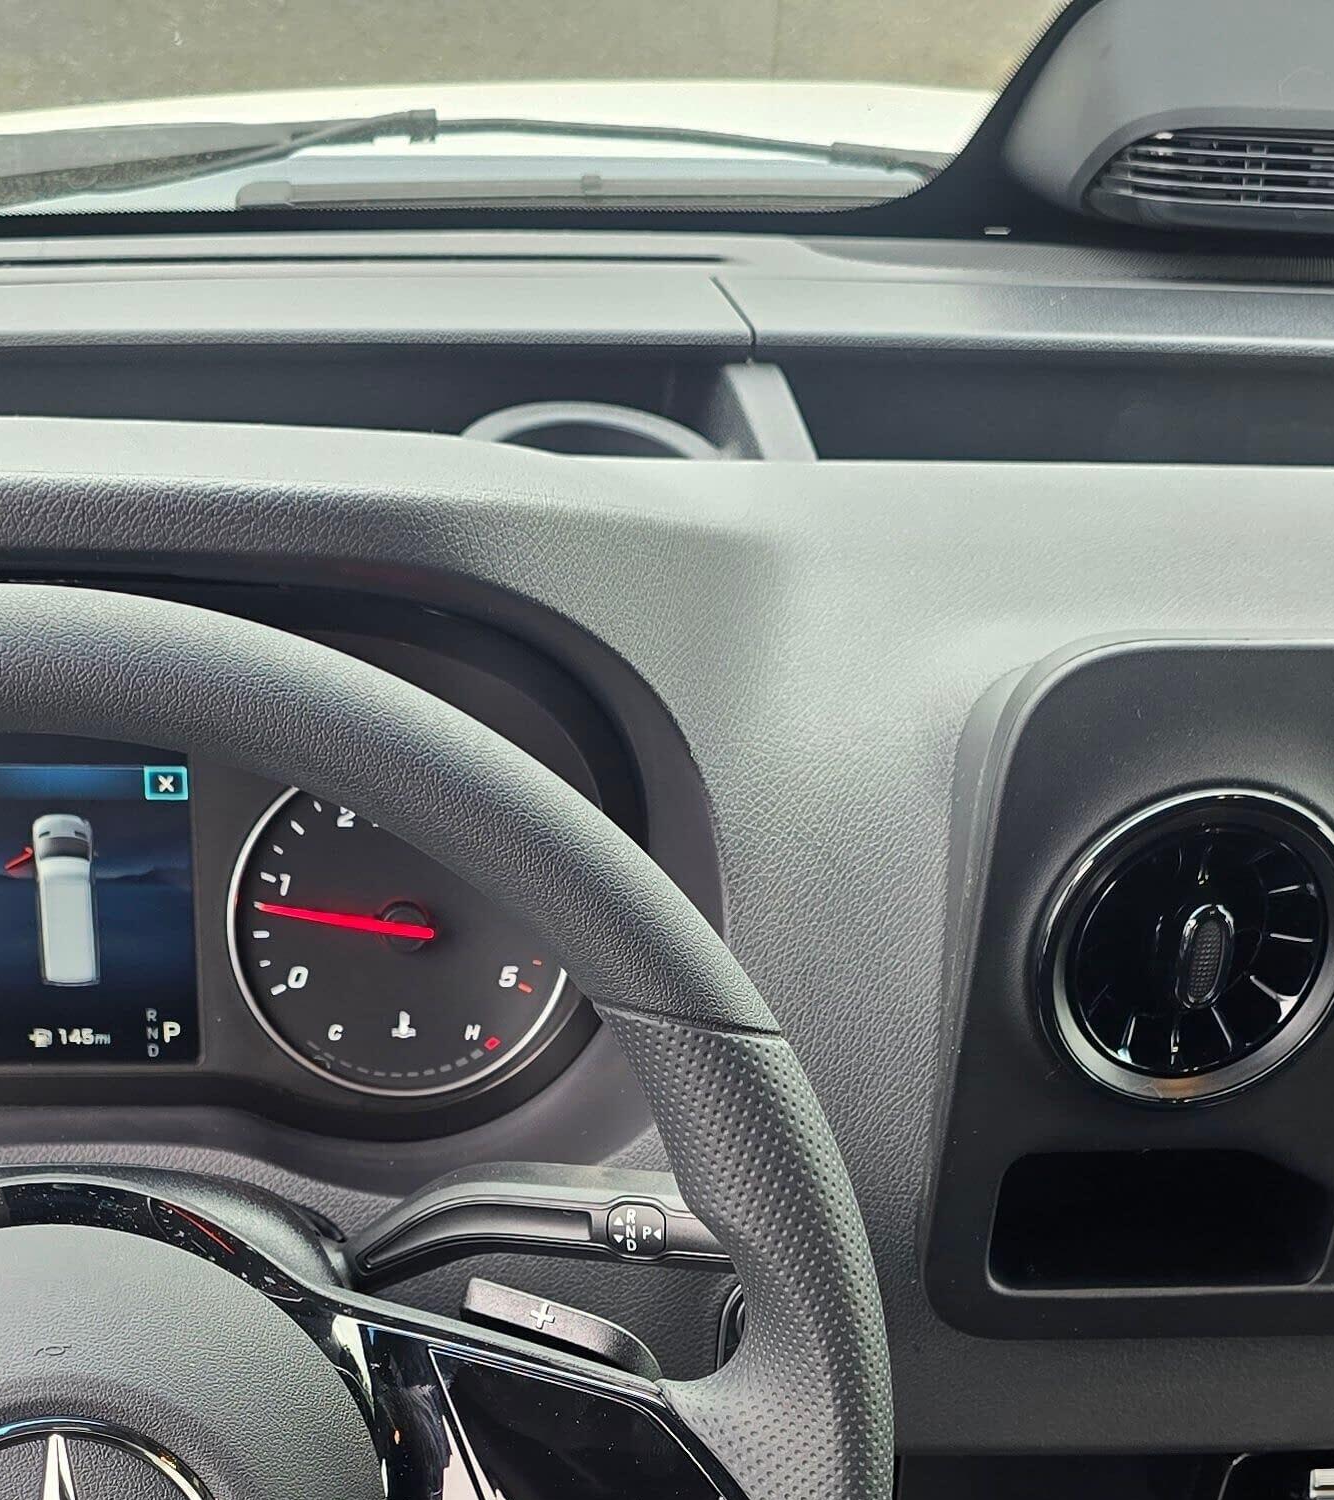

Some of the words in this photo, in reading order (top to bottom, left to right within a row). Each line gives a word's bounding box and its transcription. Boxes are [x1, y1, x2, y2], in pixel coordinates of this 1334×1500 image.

[279, 873, 291, 896] 1
[287, 966, 309, 989] 0
[498, 966, 519, 988] 5
[146, 1008, 157, 1022] R
[146, 1027, 159, 1040] N
[163, 1021, 181, 1043] P
[327, 1023, 344, 1041] C
[464, 1023, 482, 1041] H
[147, 1043, 160, 1058] D
[626, 1208, 637, 1224] R
[625, 1225, 636, 1239] N
[642, 1226, 652, 1240] P
[626, 1239, 637, 1252] D
